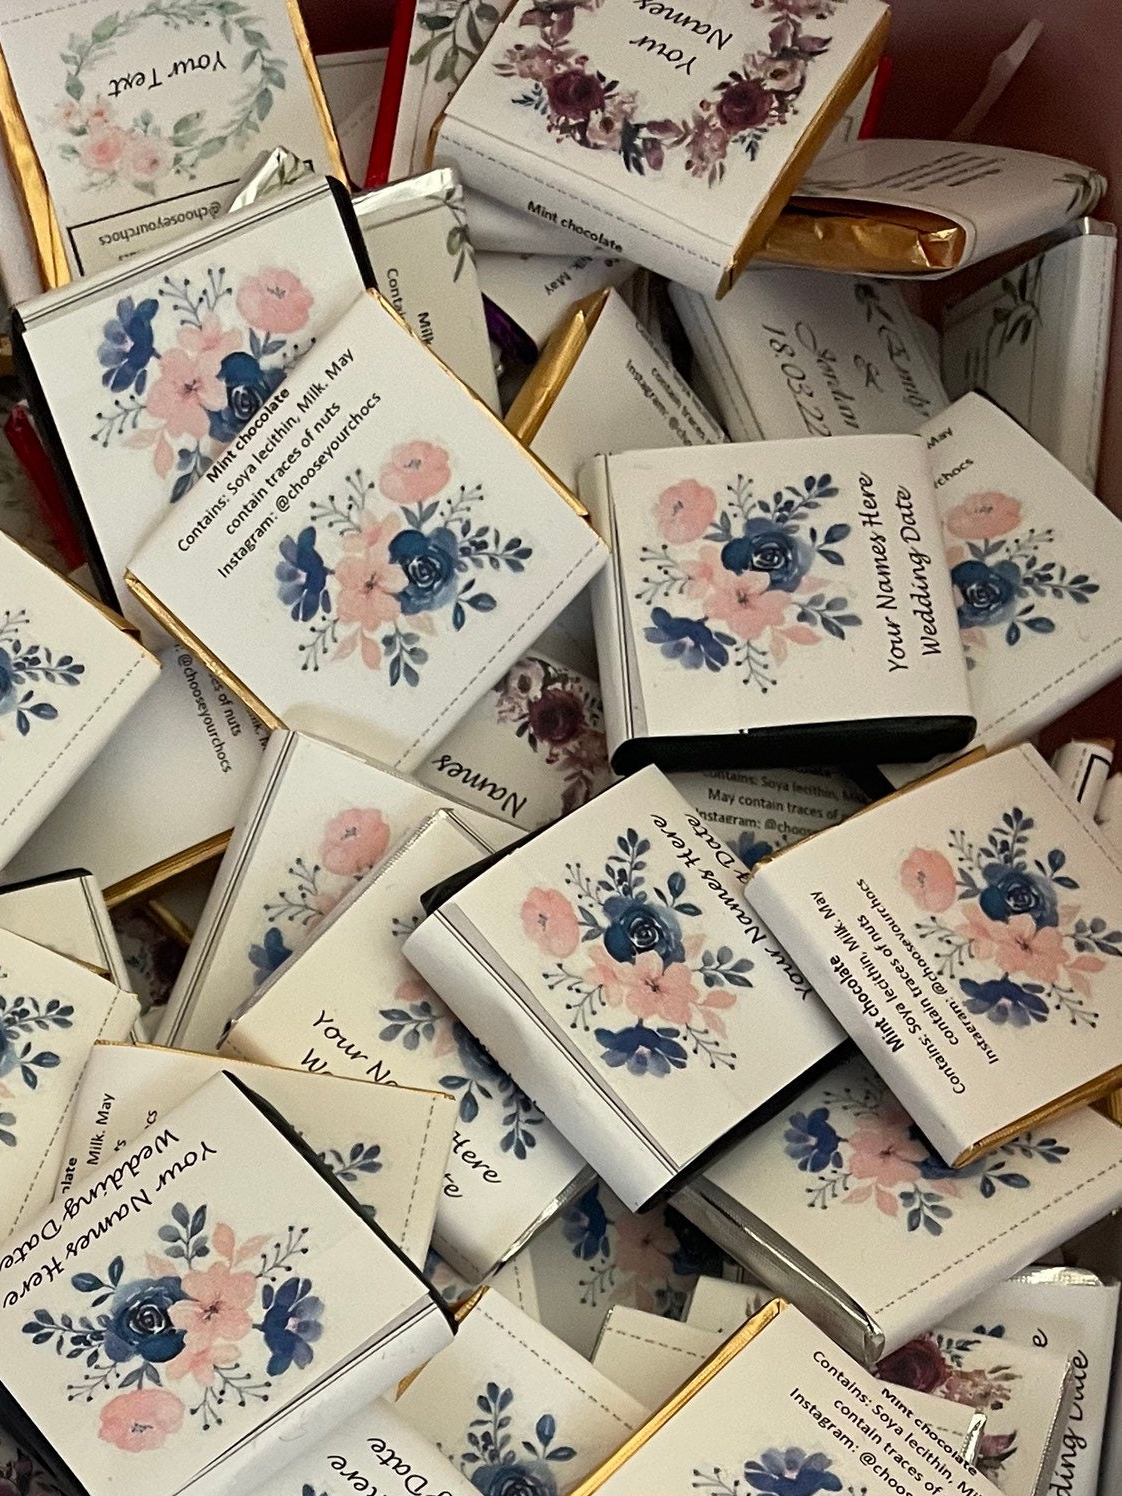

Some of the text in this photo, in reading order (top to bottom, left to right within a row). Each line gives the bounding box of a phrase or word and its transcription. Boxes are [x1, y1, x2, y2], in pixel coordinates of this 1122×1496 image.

[107, 50, 227, 98] Your Text
[628, 35, 697, 76] Your
[177, 348, 354, 552] Contains: Soya lecithin, Milk. May
[217, 392, 381, 579] Instagram: @chooseyourchocs
[226, 402, 341, 535] contain traces of nuts
[857, 471, 909, 673] Your Names Here
[894, 485, 942, 656] Wedding Date
[431, 754, 528, 819] Names
[829, 954, 905, 1053] Mint chocolate
[2, 1141, 218, 1309] Your Names Here
[62, 1129, 180, 1222] Wedding
[366, 1437, 429, 1496] Date
[789, 1387, 859, 1453] Instagram:
[813, 1351, 872, 1407] Contains:
[871, 1404, 904, 1436] Soya
[904, 1432, 953, 1484] lecithin,
